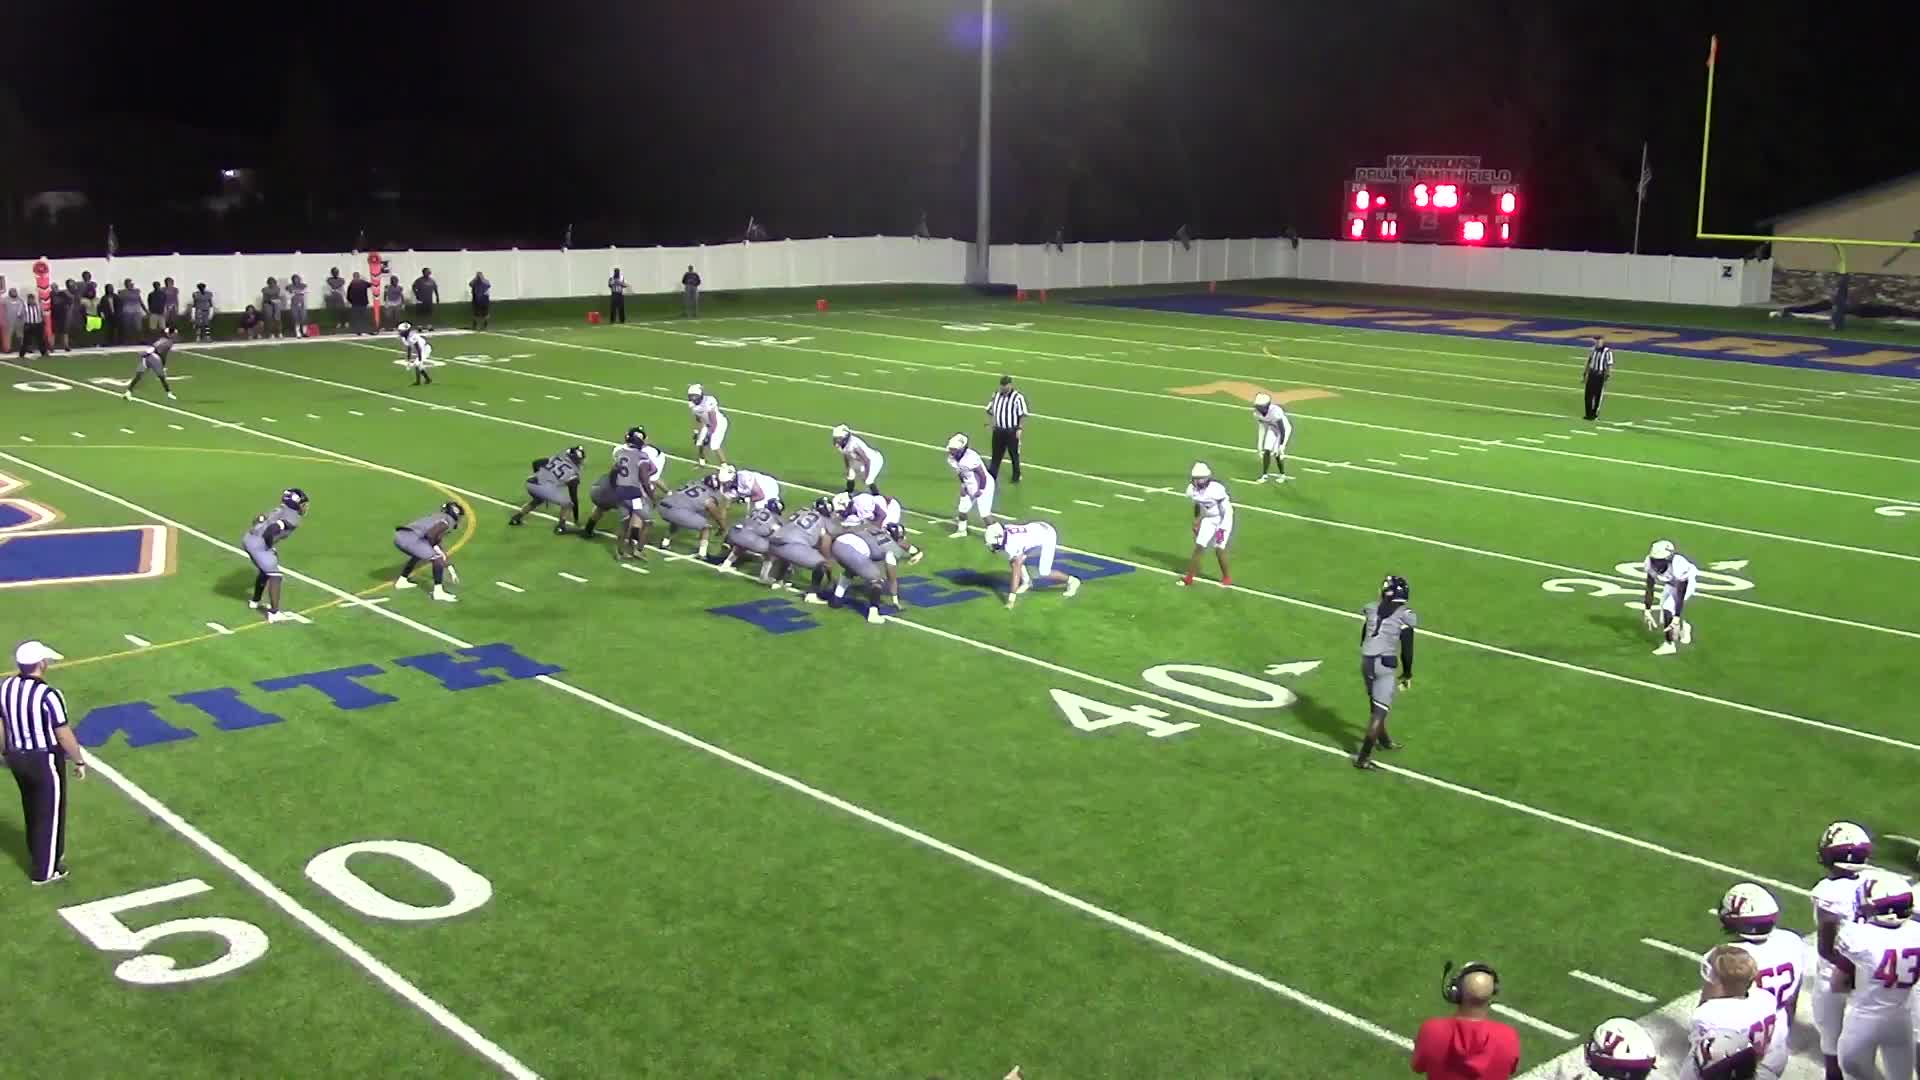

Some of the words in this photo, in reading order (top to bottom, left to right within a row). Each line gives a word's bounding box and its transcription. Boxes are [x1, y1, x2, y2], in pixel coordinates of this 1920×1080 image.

[1355, 167, 1397, 183] PAUL
[1467, 169, 1512, 184] FIELD
[1048, 663, 1298, 738] 40
[56, 839, 494, 985] 50
